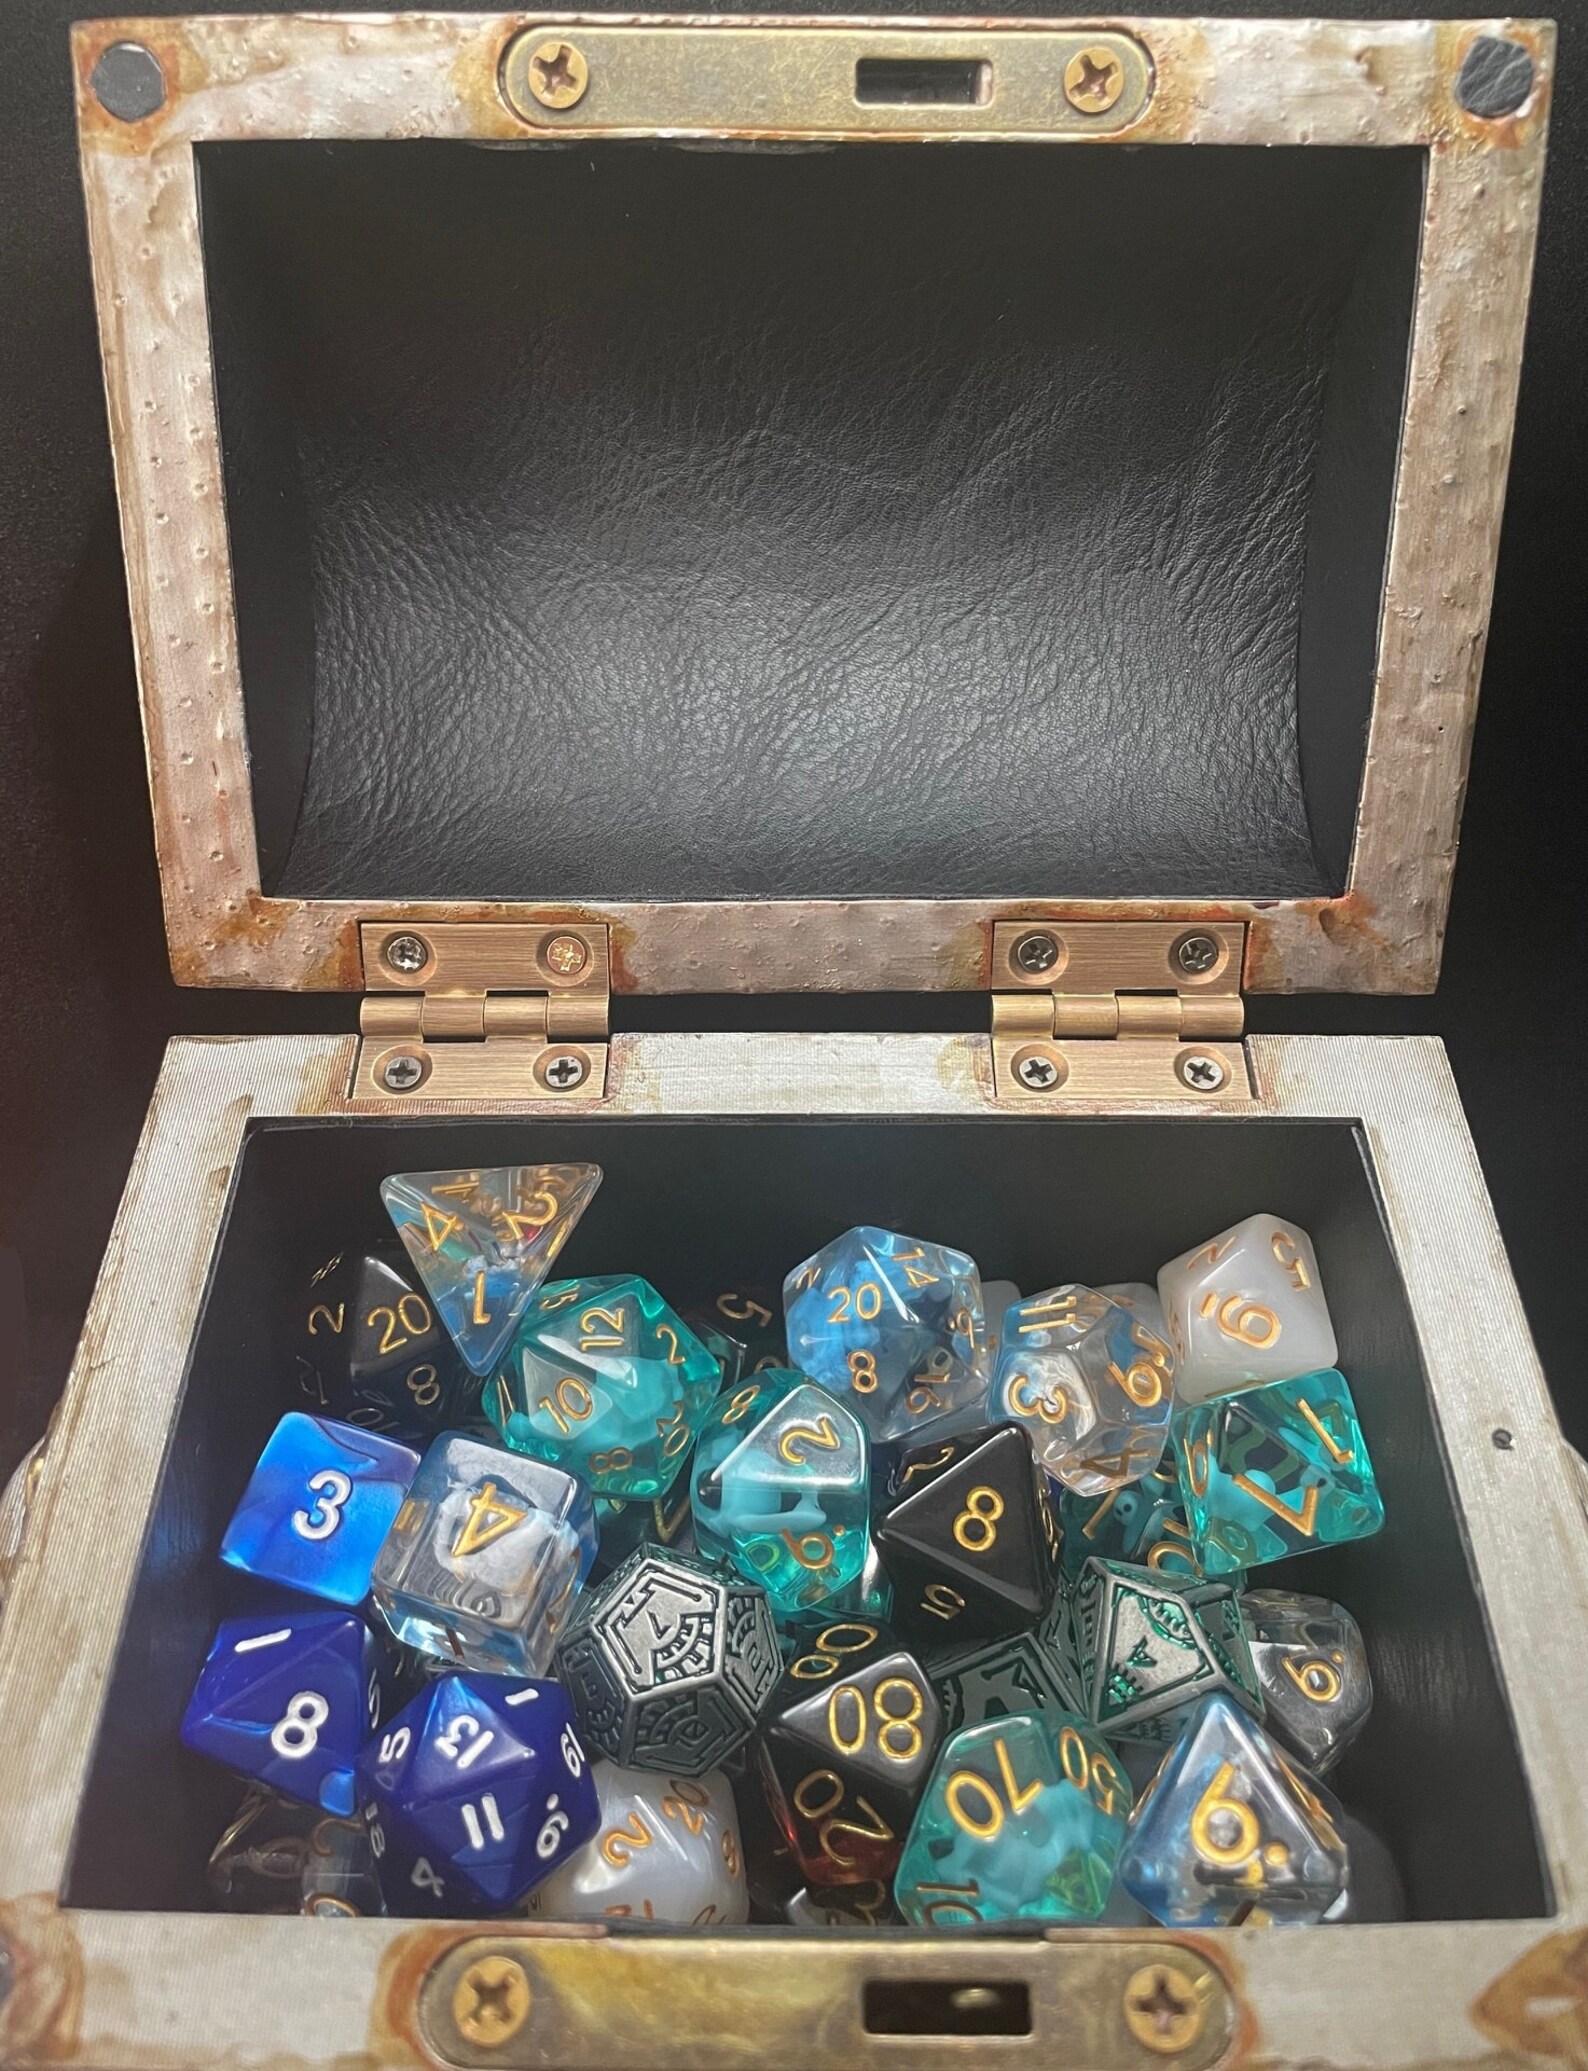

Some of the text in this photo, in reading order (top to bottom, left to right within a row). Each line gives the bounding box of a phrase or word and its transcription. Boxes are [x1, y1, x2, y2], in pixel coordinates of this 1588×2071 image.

[502, 1191, 558, 1239] 2
[308, 1303, 345, 1336] 2
[367, 1293, 433, 1354] 20
[579, 1307, 624, 1352] 12
[826, 1283, 883, 1333] 20
[655, 1324, 685, 1365] 2
[406, 1363, 441, 1406] 8
[847, 1350, 878, 1394] 8
[539, 1377, 594, 1434] 10
[721, 1384, 761, 1424] 8
[1007, 1374, 1068, 1425] 3
[588, 1446, 633, 1475] 8
[778, 1415, 840, 1466] 2
[292, 1469, 353, 1541] 3
[450, 1482, 529, 1559] 4
[953, 1485, 1005, 1552] 8
[271, 1690, 329, 1759] 8
[378, 1726, 412, 1764] 5
[434, 1714, 495, 1770] 13
[460, 1792, 505, 1850] 11
[602, 1808, 654, 1868] 2
[411, 1857, 447, 1898] 4
